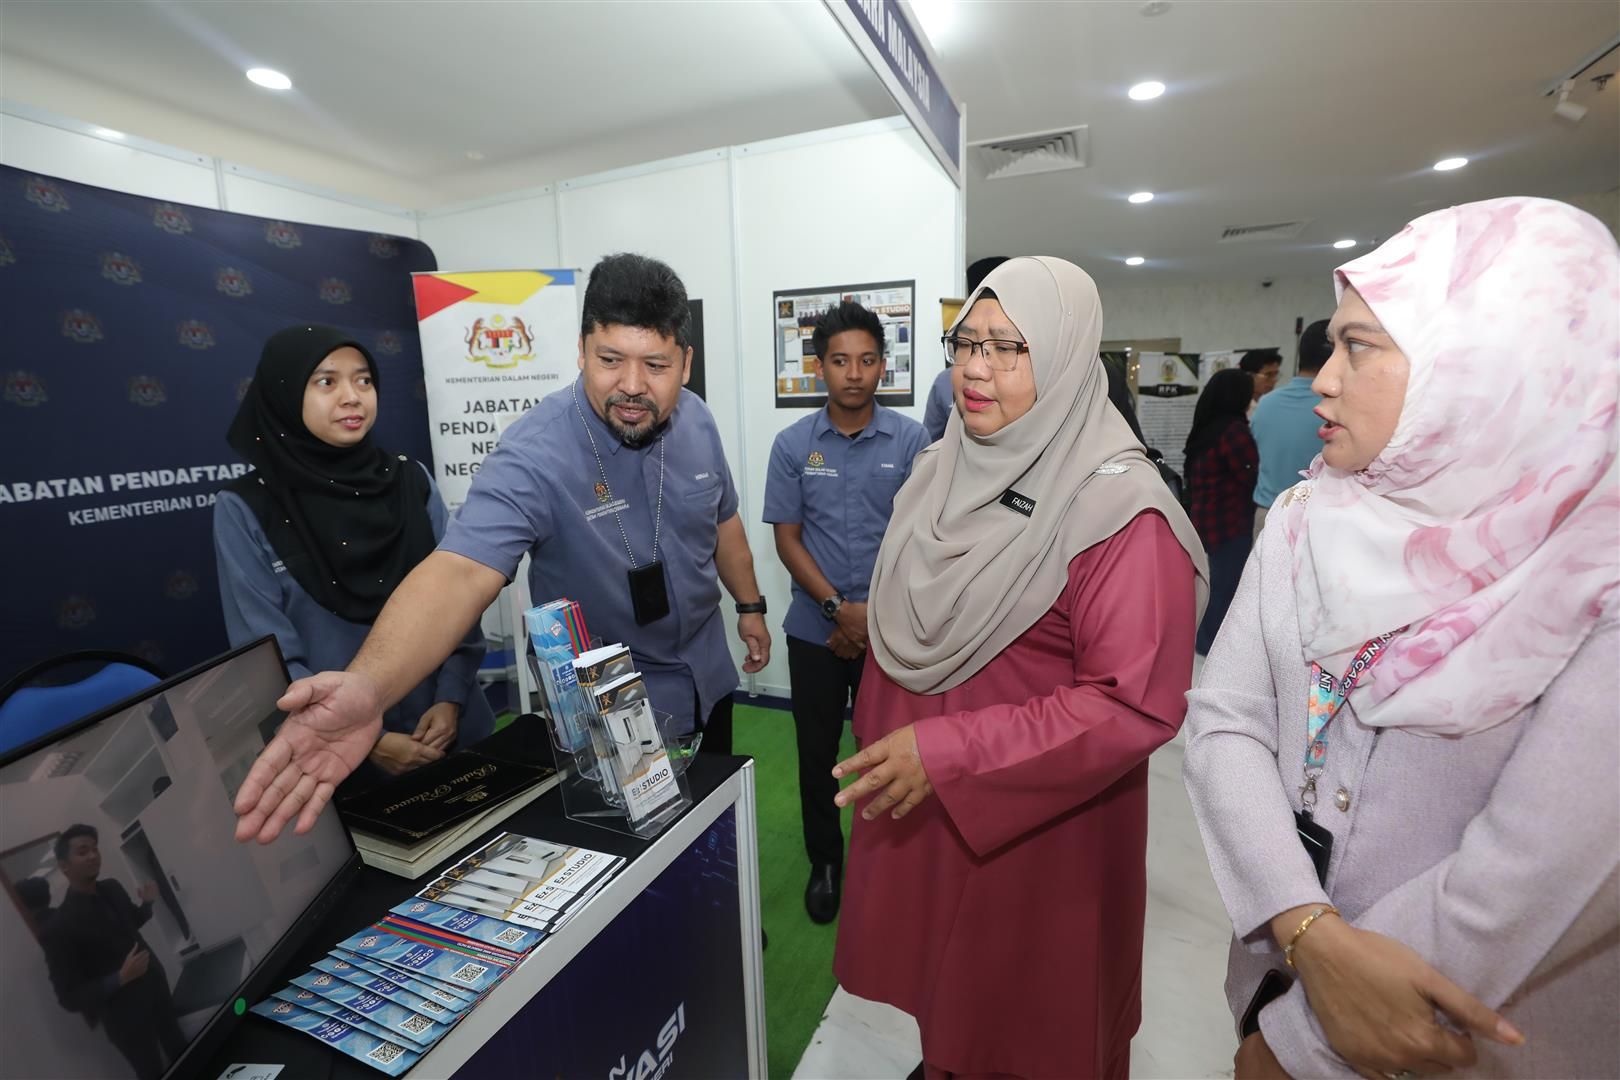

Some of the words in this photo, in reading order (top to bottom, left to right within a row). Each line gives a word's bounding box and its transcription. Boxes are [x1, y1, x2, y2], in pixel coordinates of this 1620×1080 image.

[887, 9, 930, 112] MALAYSIA
[445, 375, 500, 384] KEMENTERIAN
[502, 374, 530, 382] DALAM
[531, 373, 559, 381] NEGERI
[68, 496, 193, 526] KEMENTERIAN
[1012, 497, 1033, 512] FAIZAH
[641, 768, 669, 790] STUDIO
[563, 853, 593, 876] STUDIO
